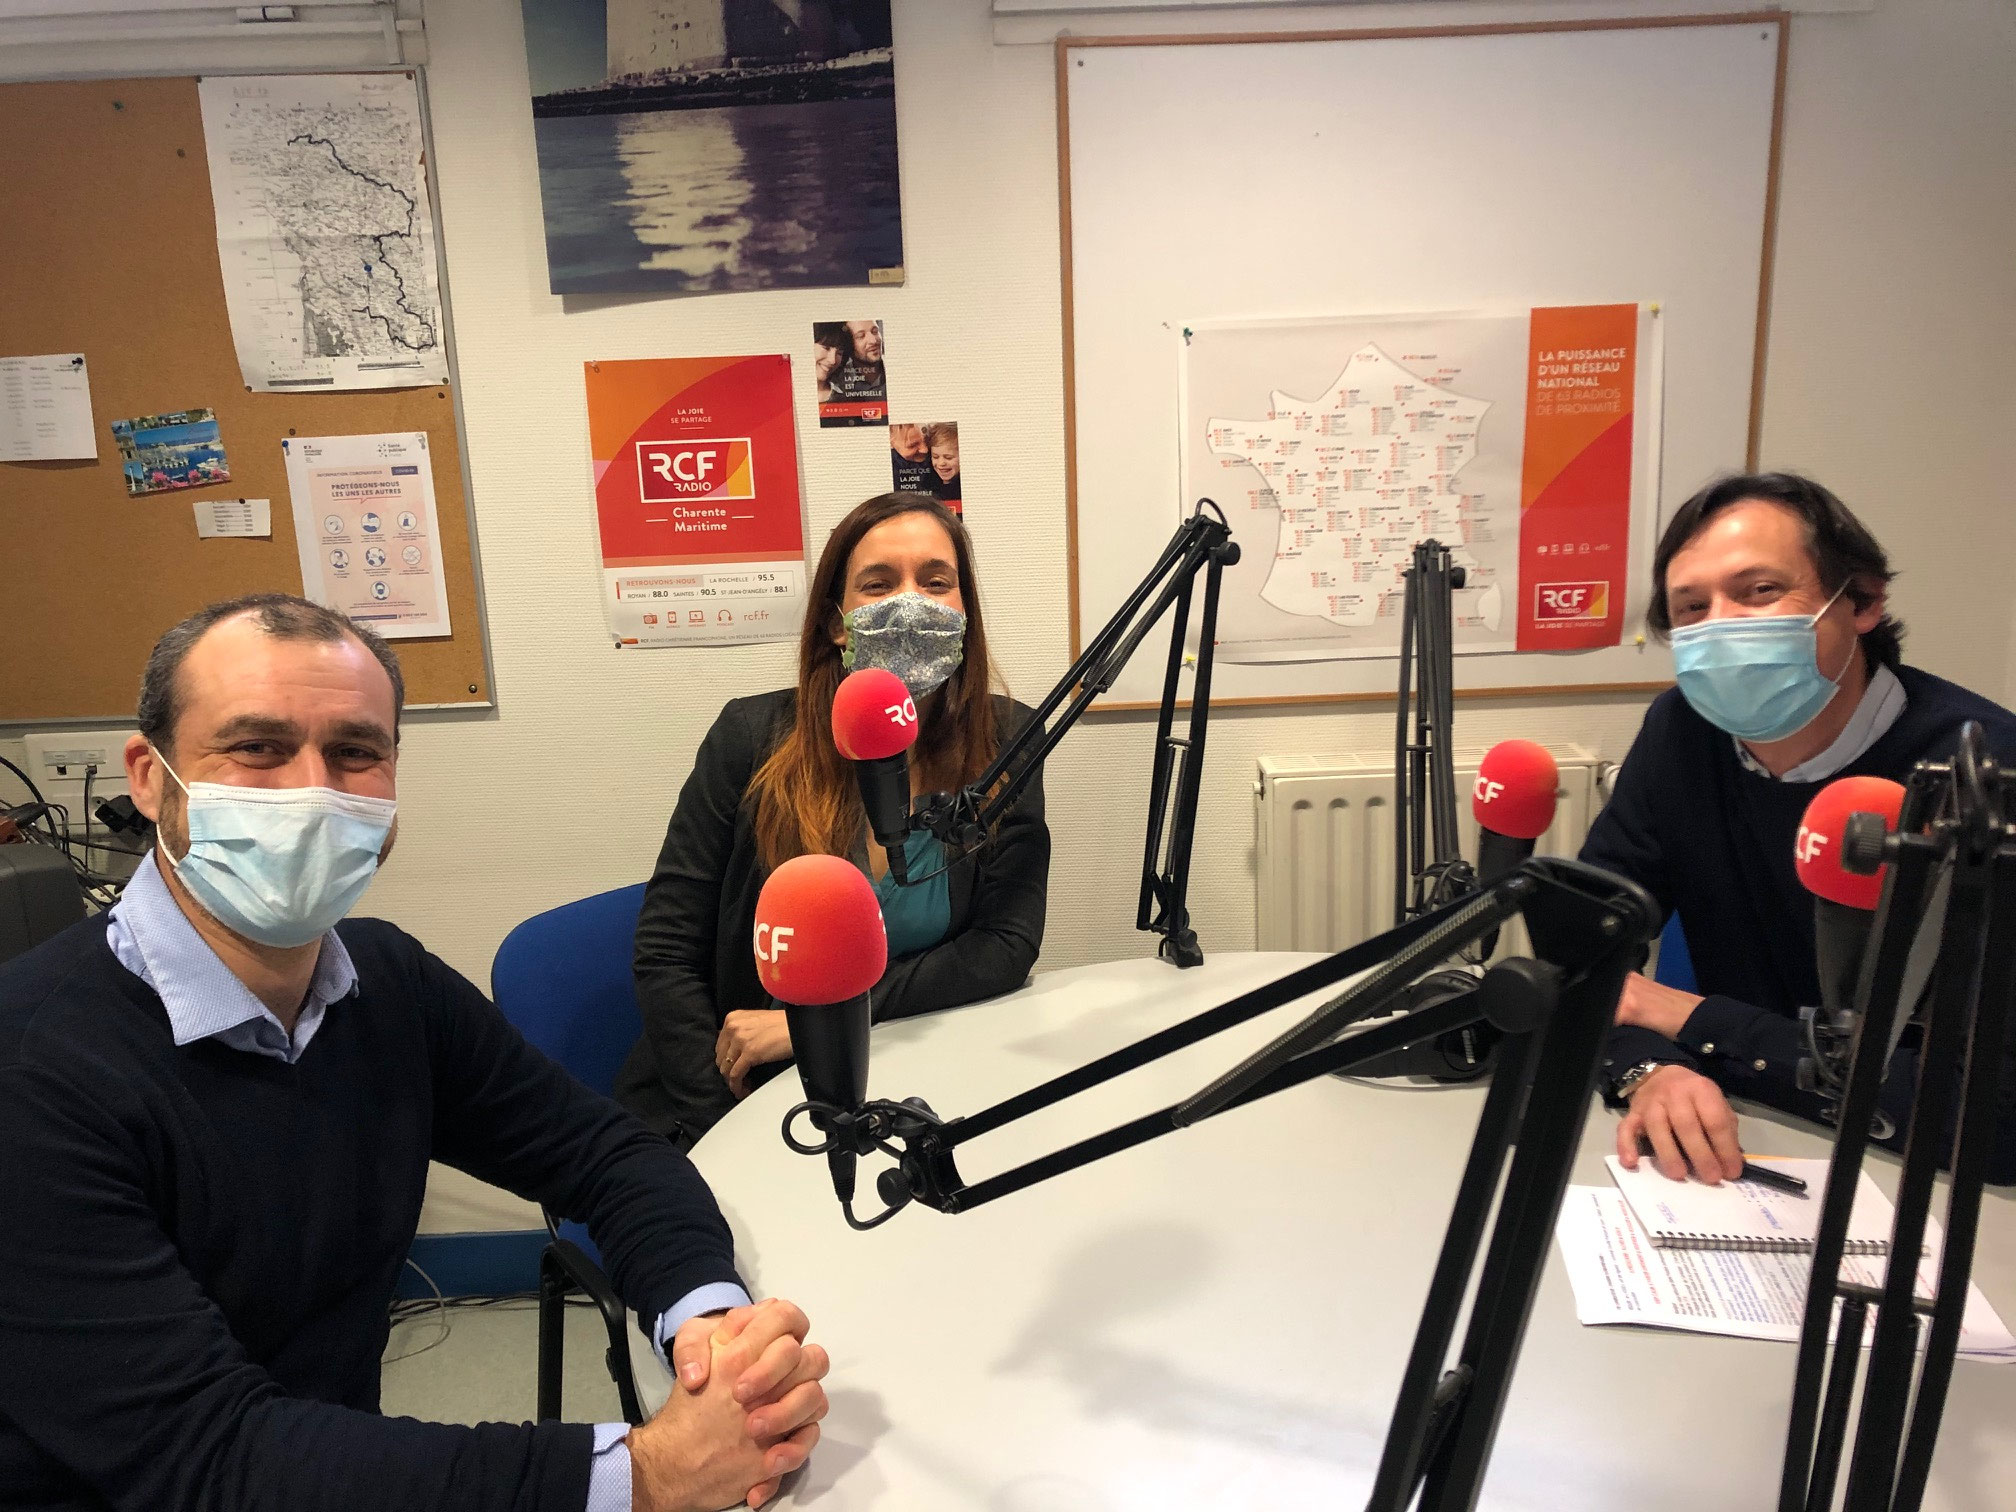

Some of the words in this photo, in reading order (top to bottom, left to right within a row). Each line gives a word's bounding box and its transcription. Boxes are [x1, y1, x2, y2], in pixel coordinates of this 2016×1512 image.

[1538, 351, 1554, 362] LA
[1557, 348, 1626, 360] PUISSANCE
[1538, 364, 1569, 376] D'UN
[1572, 361, 1620, 374] RÉSEAU
[1537, 377, 1599, 389] NATIONAL
[1537, 391, 1554, 402] DE
[1573, 388, 1621, 400] RADIOS
[1536, 404, 1553, 416] DE
[1556, 401, 1620, 414] PROXIMITÉ
[648, 450, 717, 482] RCF
[331, 481, 400, 490] PROTÉGEONS-NOUS
[673, 482, 712, 492] RADIO
[673, 507, 727, 518] Charente
[675, 521, 728, 532] Maritime
[626, 578, 696, 586] RETROUVONS-NOUS
[1542, 589, 1587, 608] RCF
[744, 610, 770, 620] rcf.fr
[884, 694, 918, 726] RC
